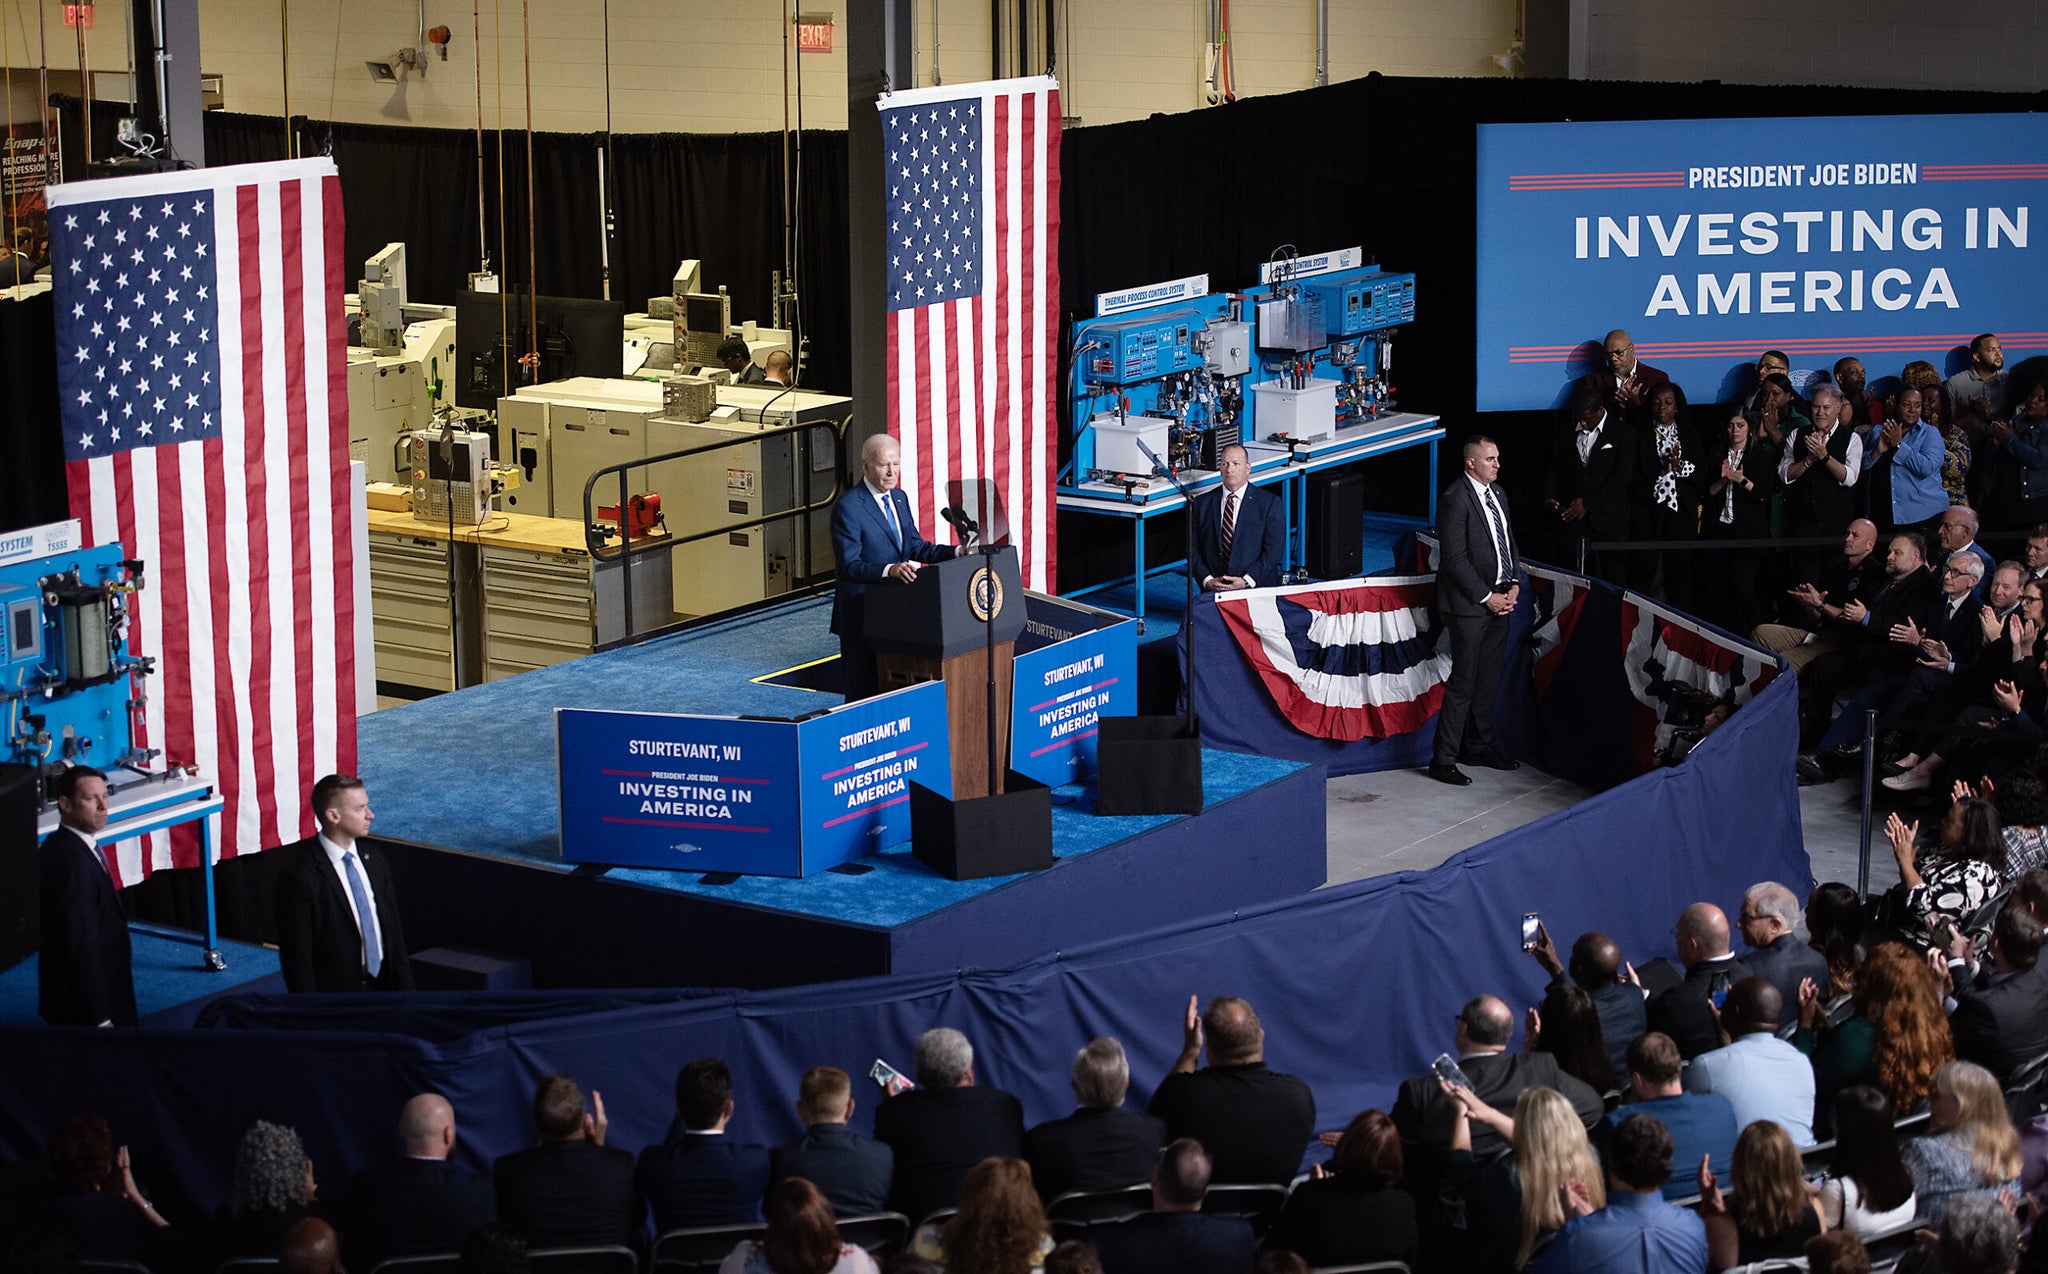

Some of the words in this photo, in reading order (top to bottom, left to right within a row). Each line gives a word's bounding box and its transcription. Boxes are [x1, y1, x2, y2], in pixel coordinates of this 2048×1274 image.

[801, 25, 824, 46] EXIT
[3, 162, 59, 176] PROFESSIONS
[39, 152, 59, 162] MRE
[1689, 165, 1805, 189] PRESIDENT
[1810, 164, 1849, 187] JOE
[1855, 163, 1917, 186] BIDEN
[1575, 208, 1942, 259] INVESTING
[1965, 207, 2029, 249] IN
[1313, 256, 1328, 267] SYSTEM
[1104, 295, 1127, 307] THERMAL
[1128, 290, 1148, 302] PROCESS
[1148, 287, 1168, 299] CONTROL
[1169, 283, 1185, 295] SYSTEM
[1645, 267, 1959, 317] AMERICA
[0, 535, 33, 553] SYSTEM
[48, 540, 67, 551] T5555
[1044, 657, 1093, 687] STURTEVANT,
[1094, 653, 1104, 669] WI
[1039, 696, 1096, 727] INVESTING
[1098, 691, 1109, 706] IN
[839, 721, 898, 752] STURTEVANT,
[898, 716, 910, 733] WI
[1050, 711, 1099, 739] AMERICA
[629, 739, 720, 762] STURTEVANT,
[723, 746, 741, 760] WI
[651, 771, 686, 780] PRESIDENT
[686, 773, 698, 781] JOE
[699, 774, 719, 782] BIDEN
[834, 762, 902, 796] INVESTING
[904, 757, 918, 772] IN
[620, 782, 727, 801] INVESTING
[732, 789, 752, 803] IN
[847, 778, 905, 808] AMERICA
[640, 800, 732, 819] AMERICA
